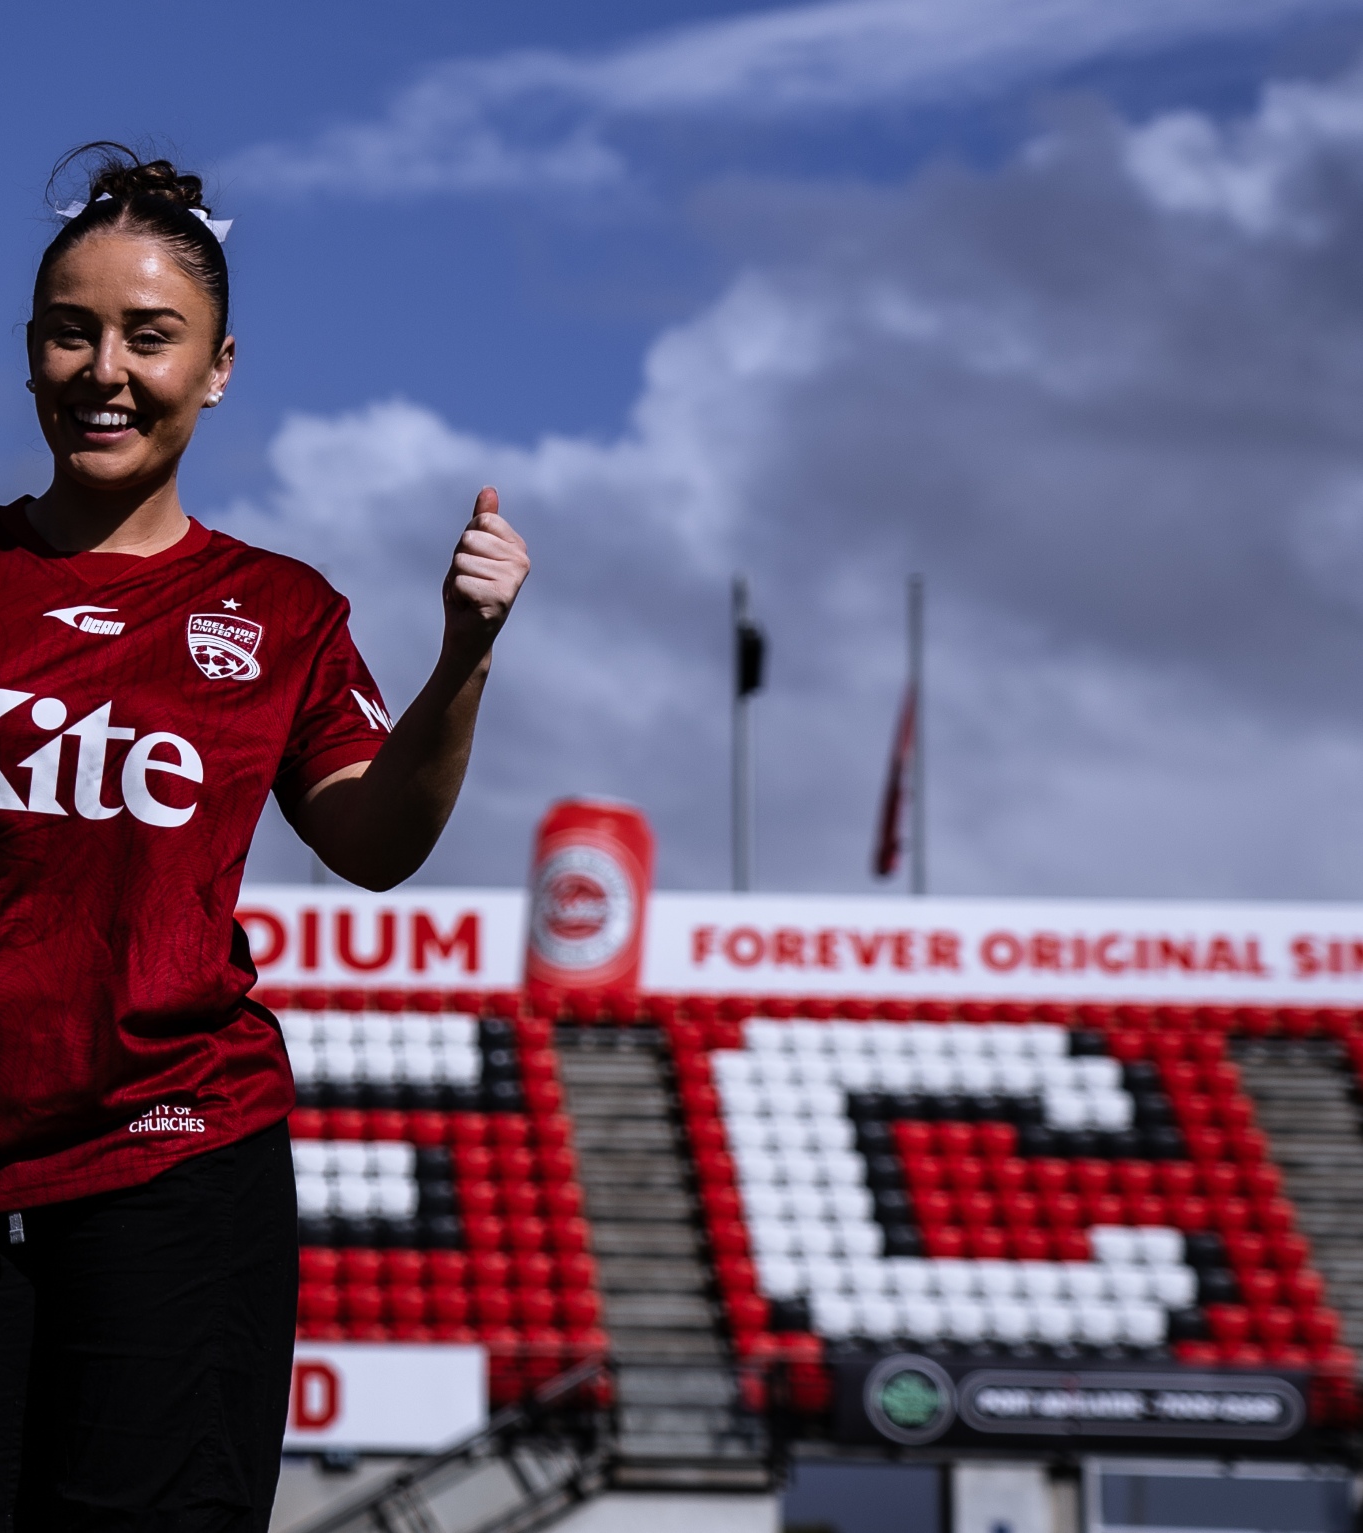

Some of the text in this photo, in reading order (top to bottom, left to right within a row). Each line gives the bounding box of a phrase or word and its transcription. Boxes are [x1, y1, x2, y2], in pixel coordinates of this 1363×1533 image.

[192, 618, 257, 640] ADELAIDE
[192, 624, 254, 645] UNITED F.C.
[692, 926, 962, 972] FOREVER
[979, 931, 1271, 979] ORIGINAL
[128, 1117, 206, 1133] CHURCHES
